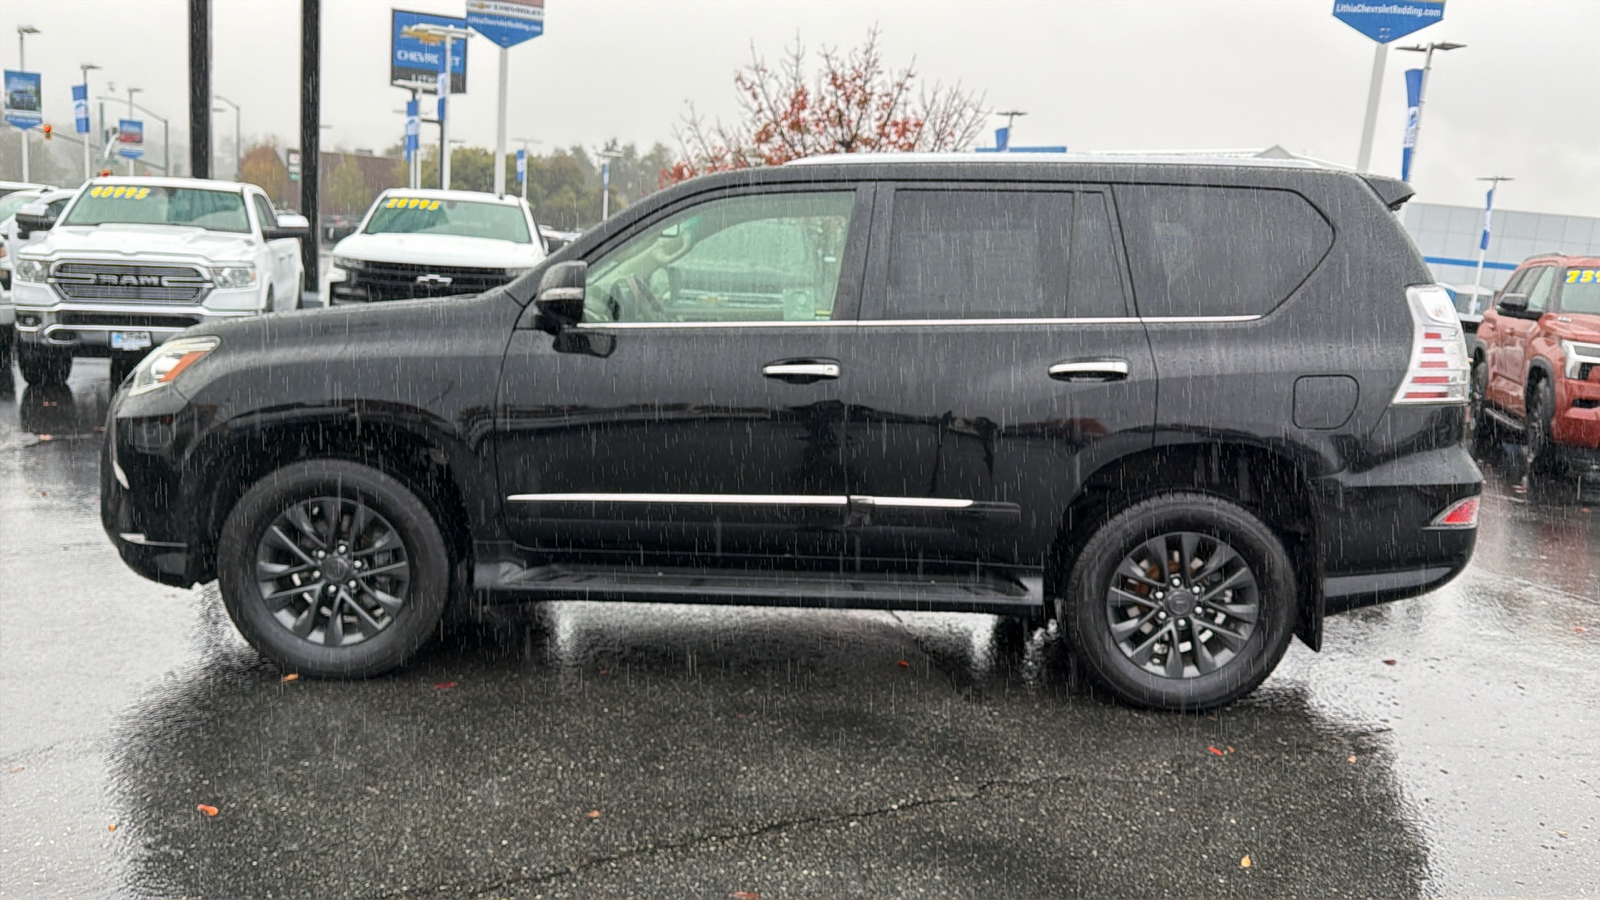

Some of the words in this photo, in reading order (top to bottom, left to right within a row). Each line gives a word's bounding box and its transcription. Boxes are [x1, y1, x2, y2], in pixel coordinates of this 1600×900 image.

[1336, 3, 1441, 17] LithiaChevroletRedding.com
[396, 49, 461, 67] CHEVRET
[98, 274, 160, 286] RAM
